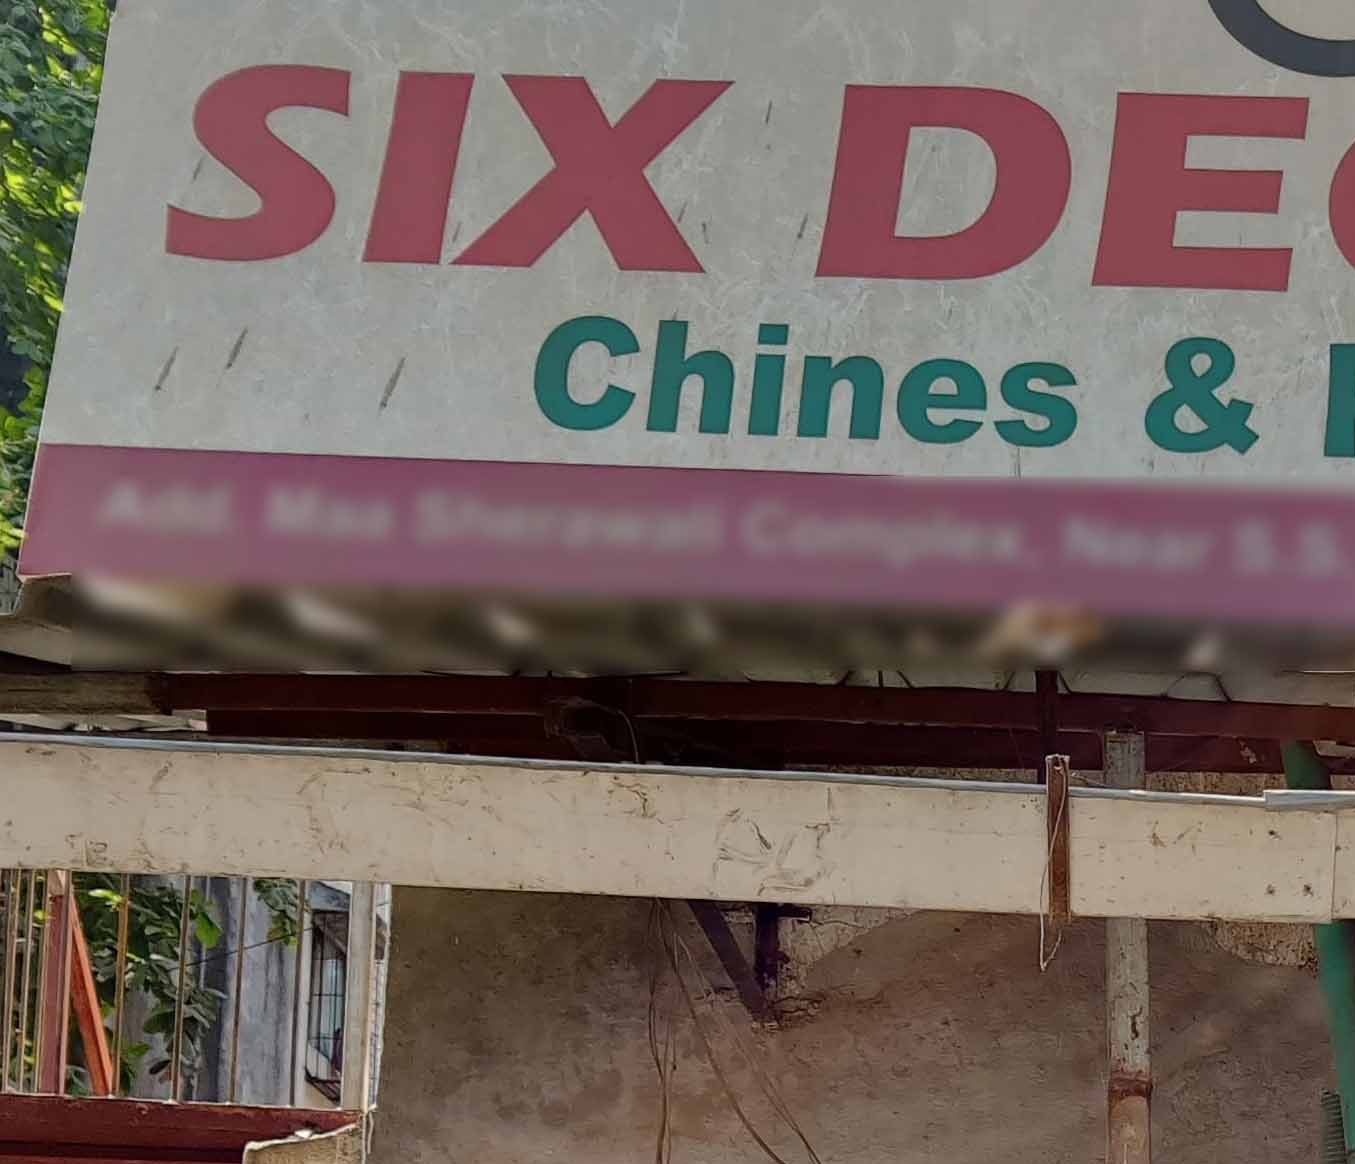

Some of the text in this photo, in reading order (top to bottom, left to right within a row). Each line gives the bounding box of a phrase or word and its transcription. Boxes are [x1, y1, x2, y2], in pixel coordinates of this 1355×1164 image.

[165, 63, 732, 273] SIX
[534, 316, 1077, 448] Chines
[1144, 336, 1260, 455] &
